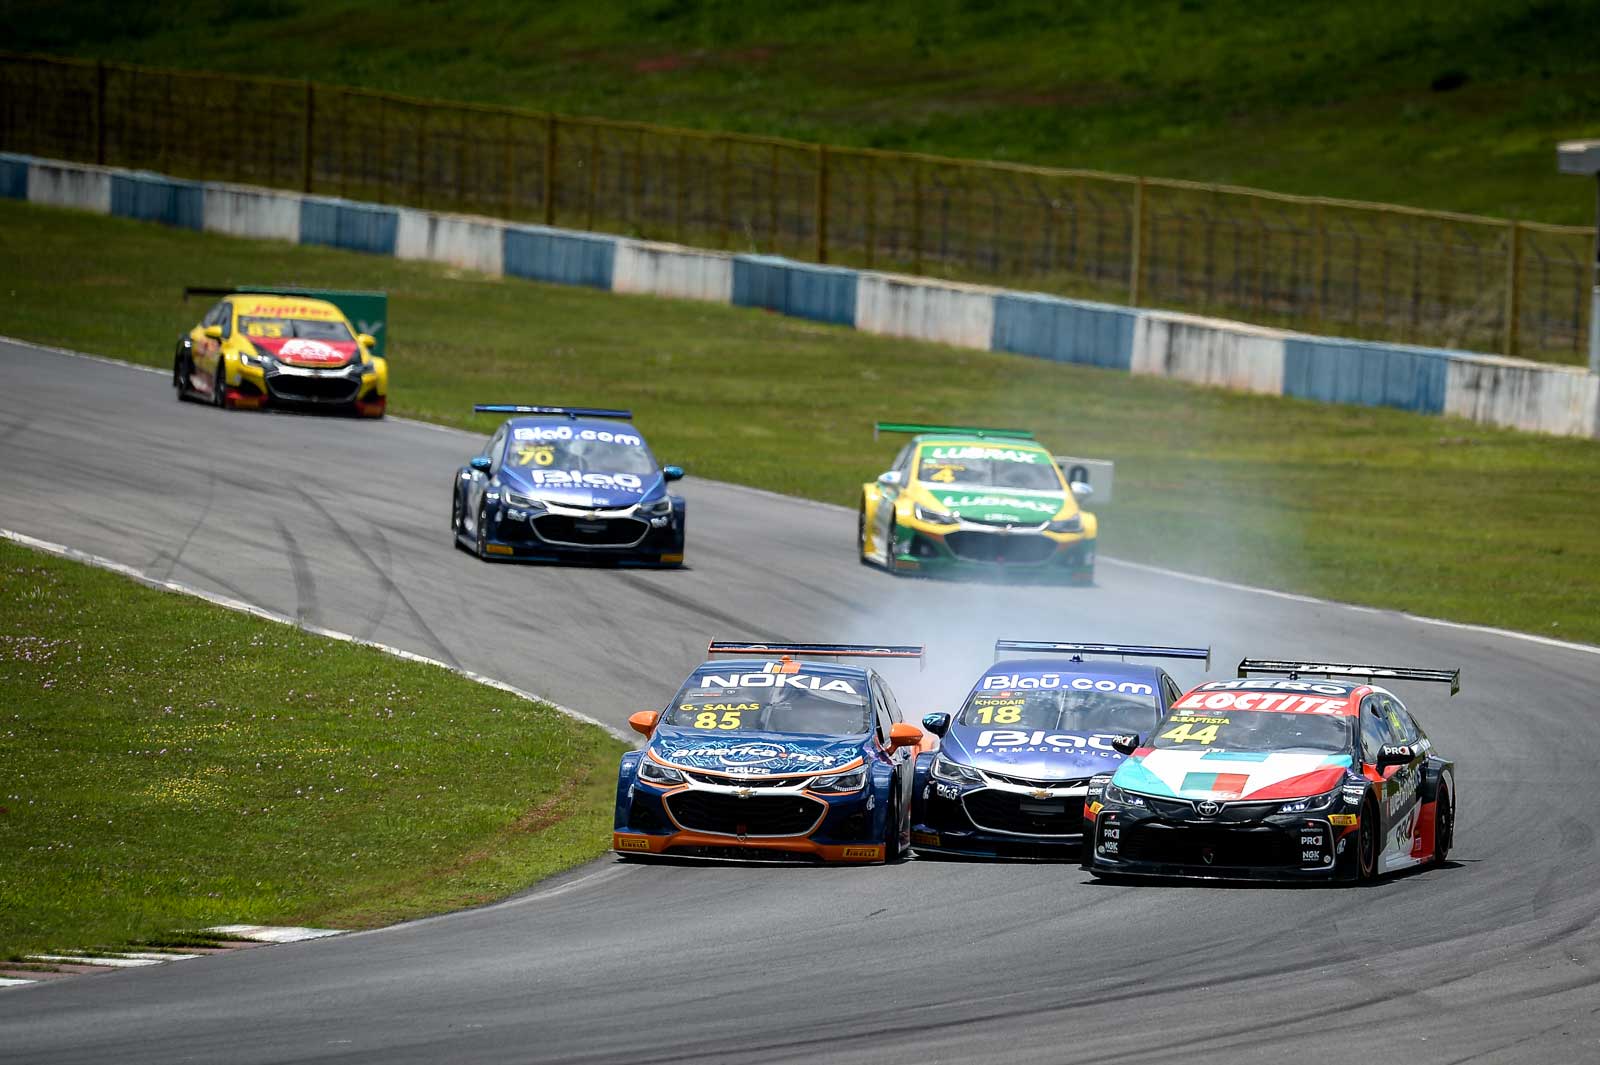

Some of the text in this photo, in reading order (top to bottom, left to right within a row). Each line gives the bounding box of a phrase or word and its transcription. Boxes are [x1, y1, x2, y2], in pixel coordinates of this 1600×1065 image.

[518, 450, 554, 465] 70
[932, 447, 1037, 463] LUBRAX
[931, 468, 955, 483] 4
[943, 496, 1058, 514] LUBRAX
[701, 673, 857, 694] NOKIA
[1202, 680, 1347, 694] HERO
[703, 703, 760, 711] SALAS
[694, 712, 741, 729] 85
[978, 706, 1021, 724] 18
[1180, 717, 1230, 725] BAPTISTA
[1160, 723, 1219, 745] 44
[725, 767, 771, 775] CRUZE
[1105, 842, 1118, 850] NGK
[1302, 851, 1320, 859] NGK
